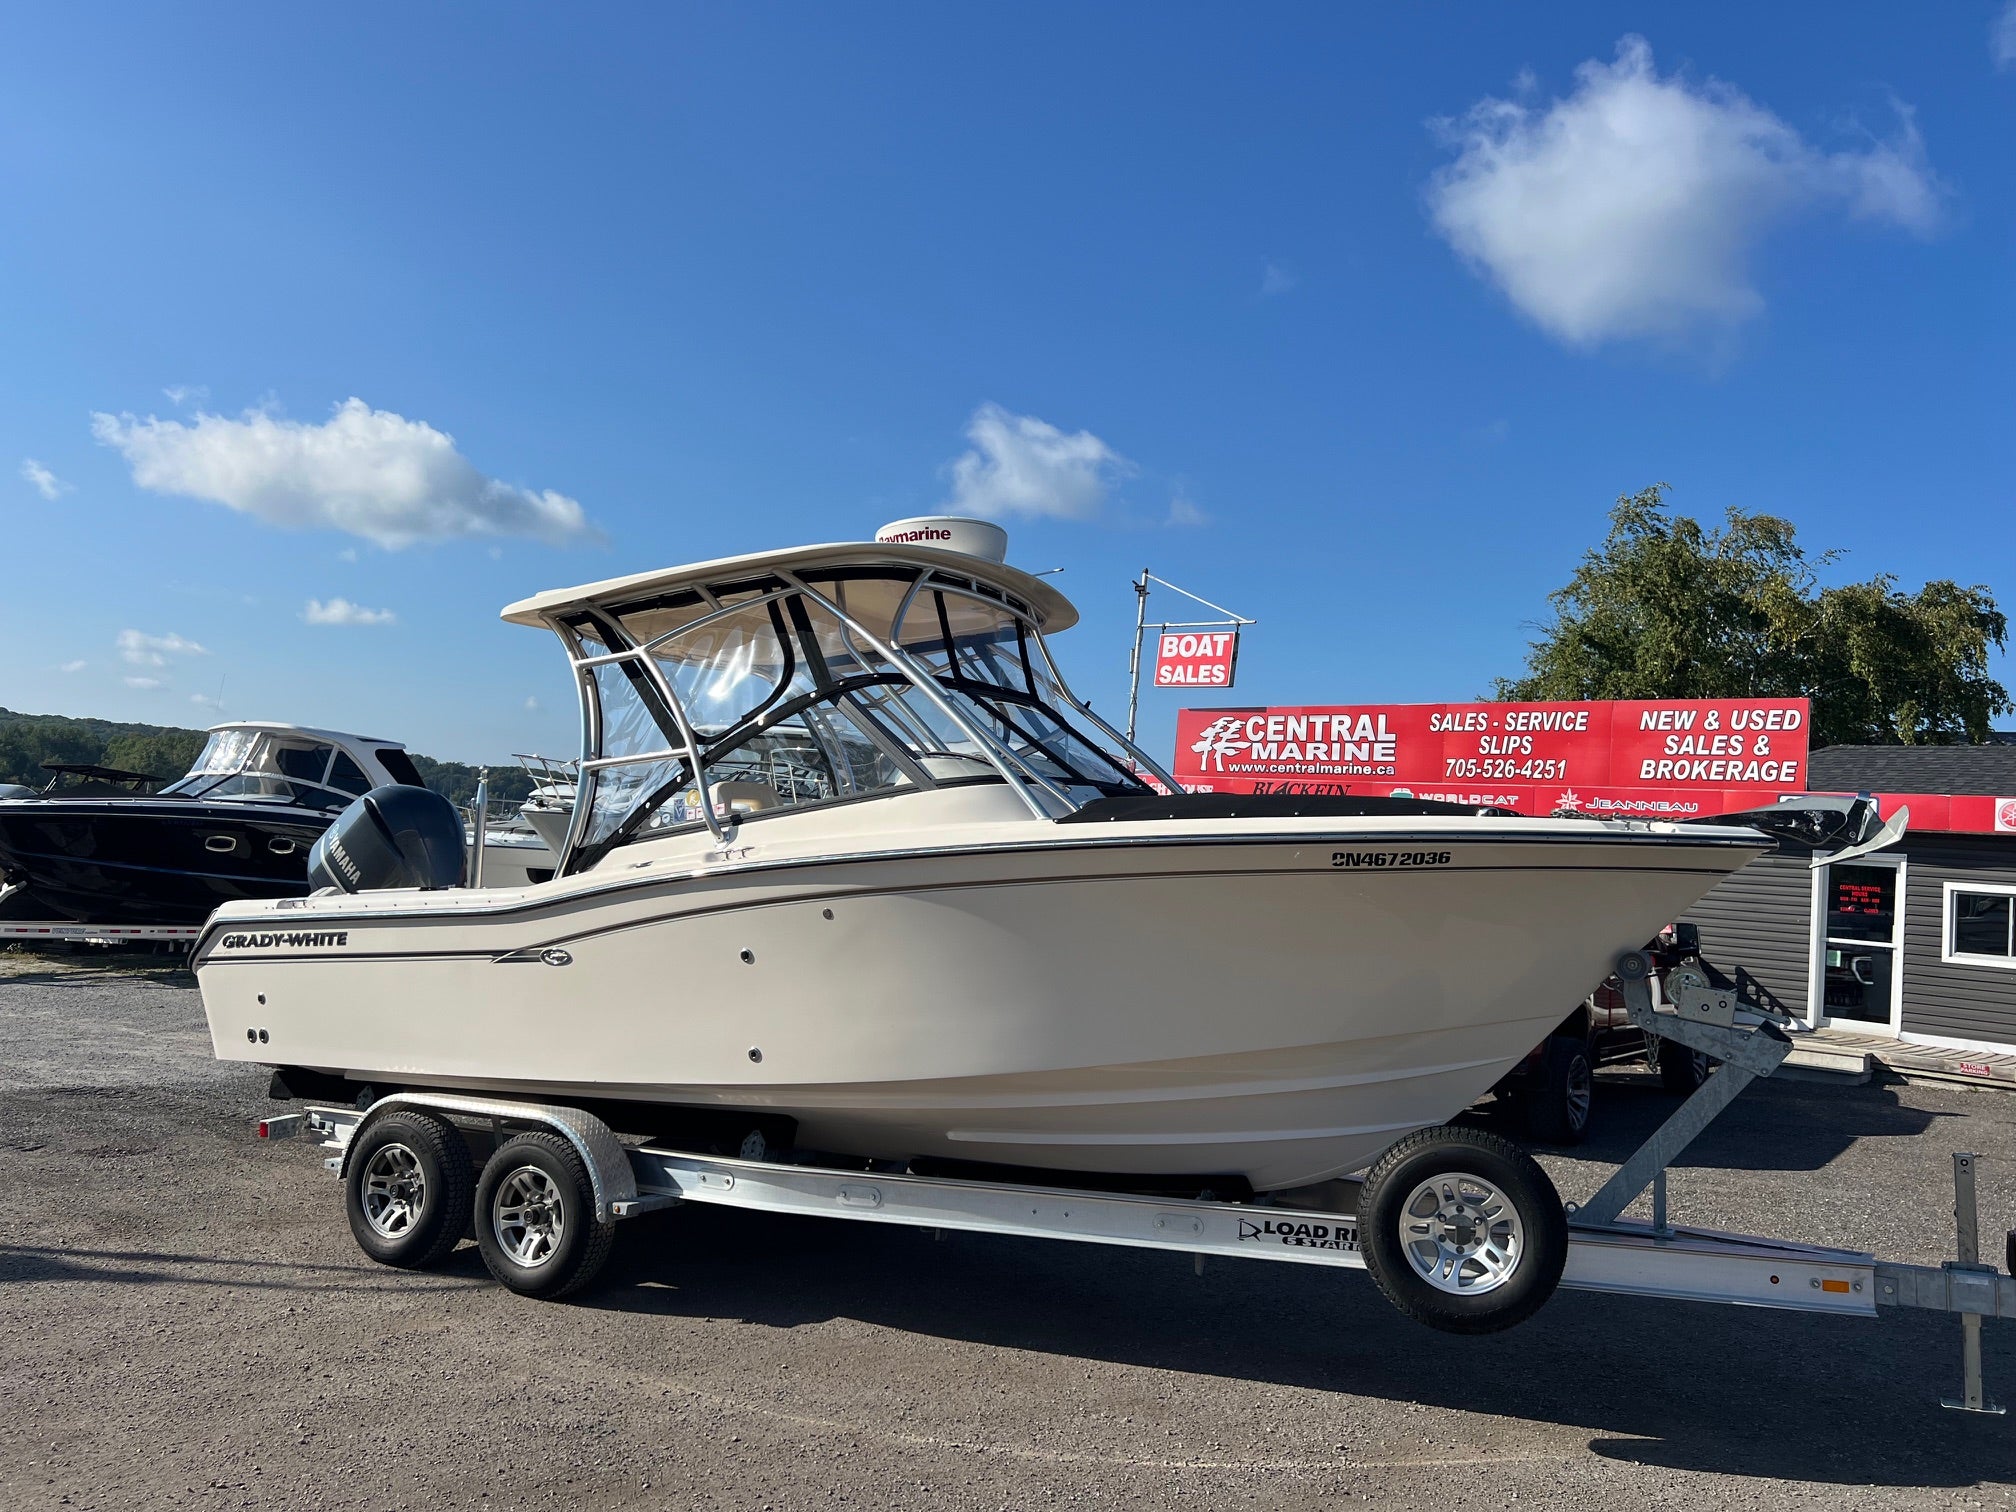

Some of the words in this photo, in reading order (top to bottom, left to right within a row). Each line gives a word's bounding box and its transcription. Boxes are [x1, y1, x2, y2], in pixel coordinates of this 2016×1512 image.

[1162, 634, 1230, 658] BOAT
[1158, 664, 1226, 684] SALES
[1245, 713, 1397, 742] CENTRAL
[1429, 711, 1489, 732] SALES
[1504, 711, 1590, 732] SERVICE
[1639, 710, 1698, 731] NEW
[1703, 709, 1720, 731] &
[1730, 709, 1802, 731] USED
[1250, 742, 1397, 762] MARINE
[1478, 735, 1534, 755] SLIPS
[1663, 734, 1745, 756] SALES
[1753, 734, 1771, 756] &
[1228, 762, 1396, 776] www.centralmarine.ca
[1445, 758, 1568, 780] 705-526-4251
[1639, 759, 1799, 783] BROKERAGE
[1253, 780, 1352, 797] BLACKFIN
[1419, 793, 1519, 806] WORLDCAT
[1585, 797, 1699, 812] JEANNEAU
[329, 832, 362, 886] YAMAHA
[222, 931, 348, 949] GRADY-WHITE
[1264, 1220, 1329, 1239] LOAD
